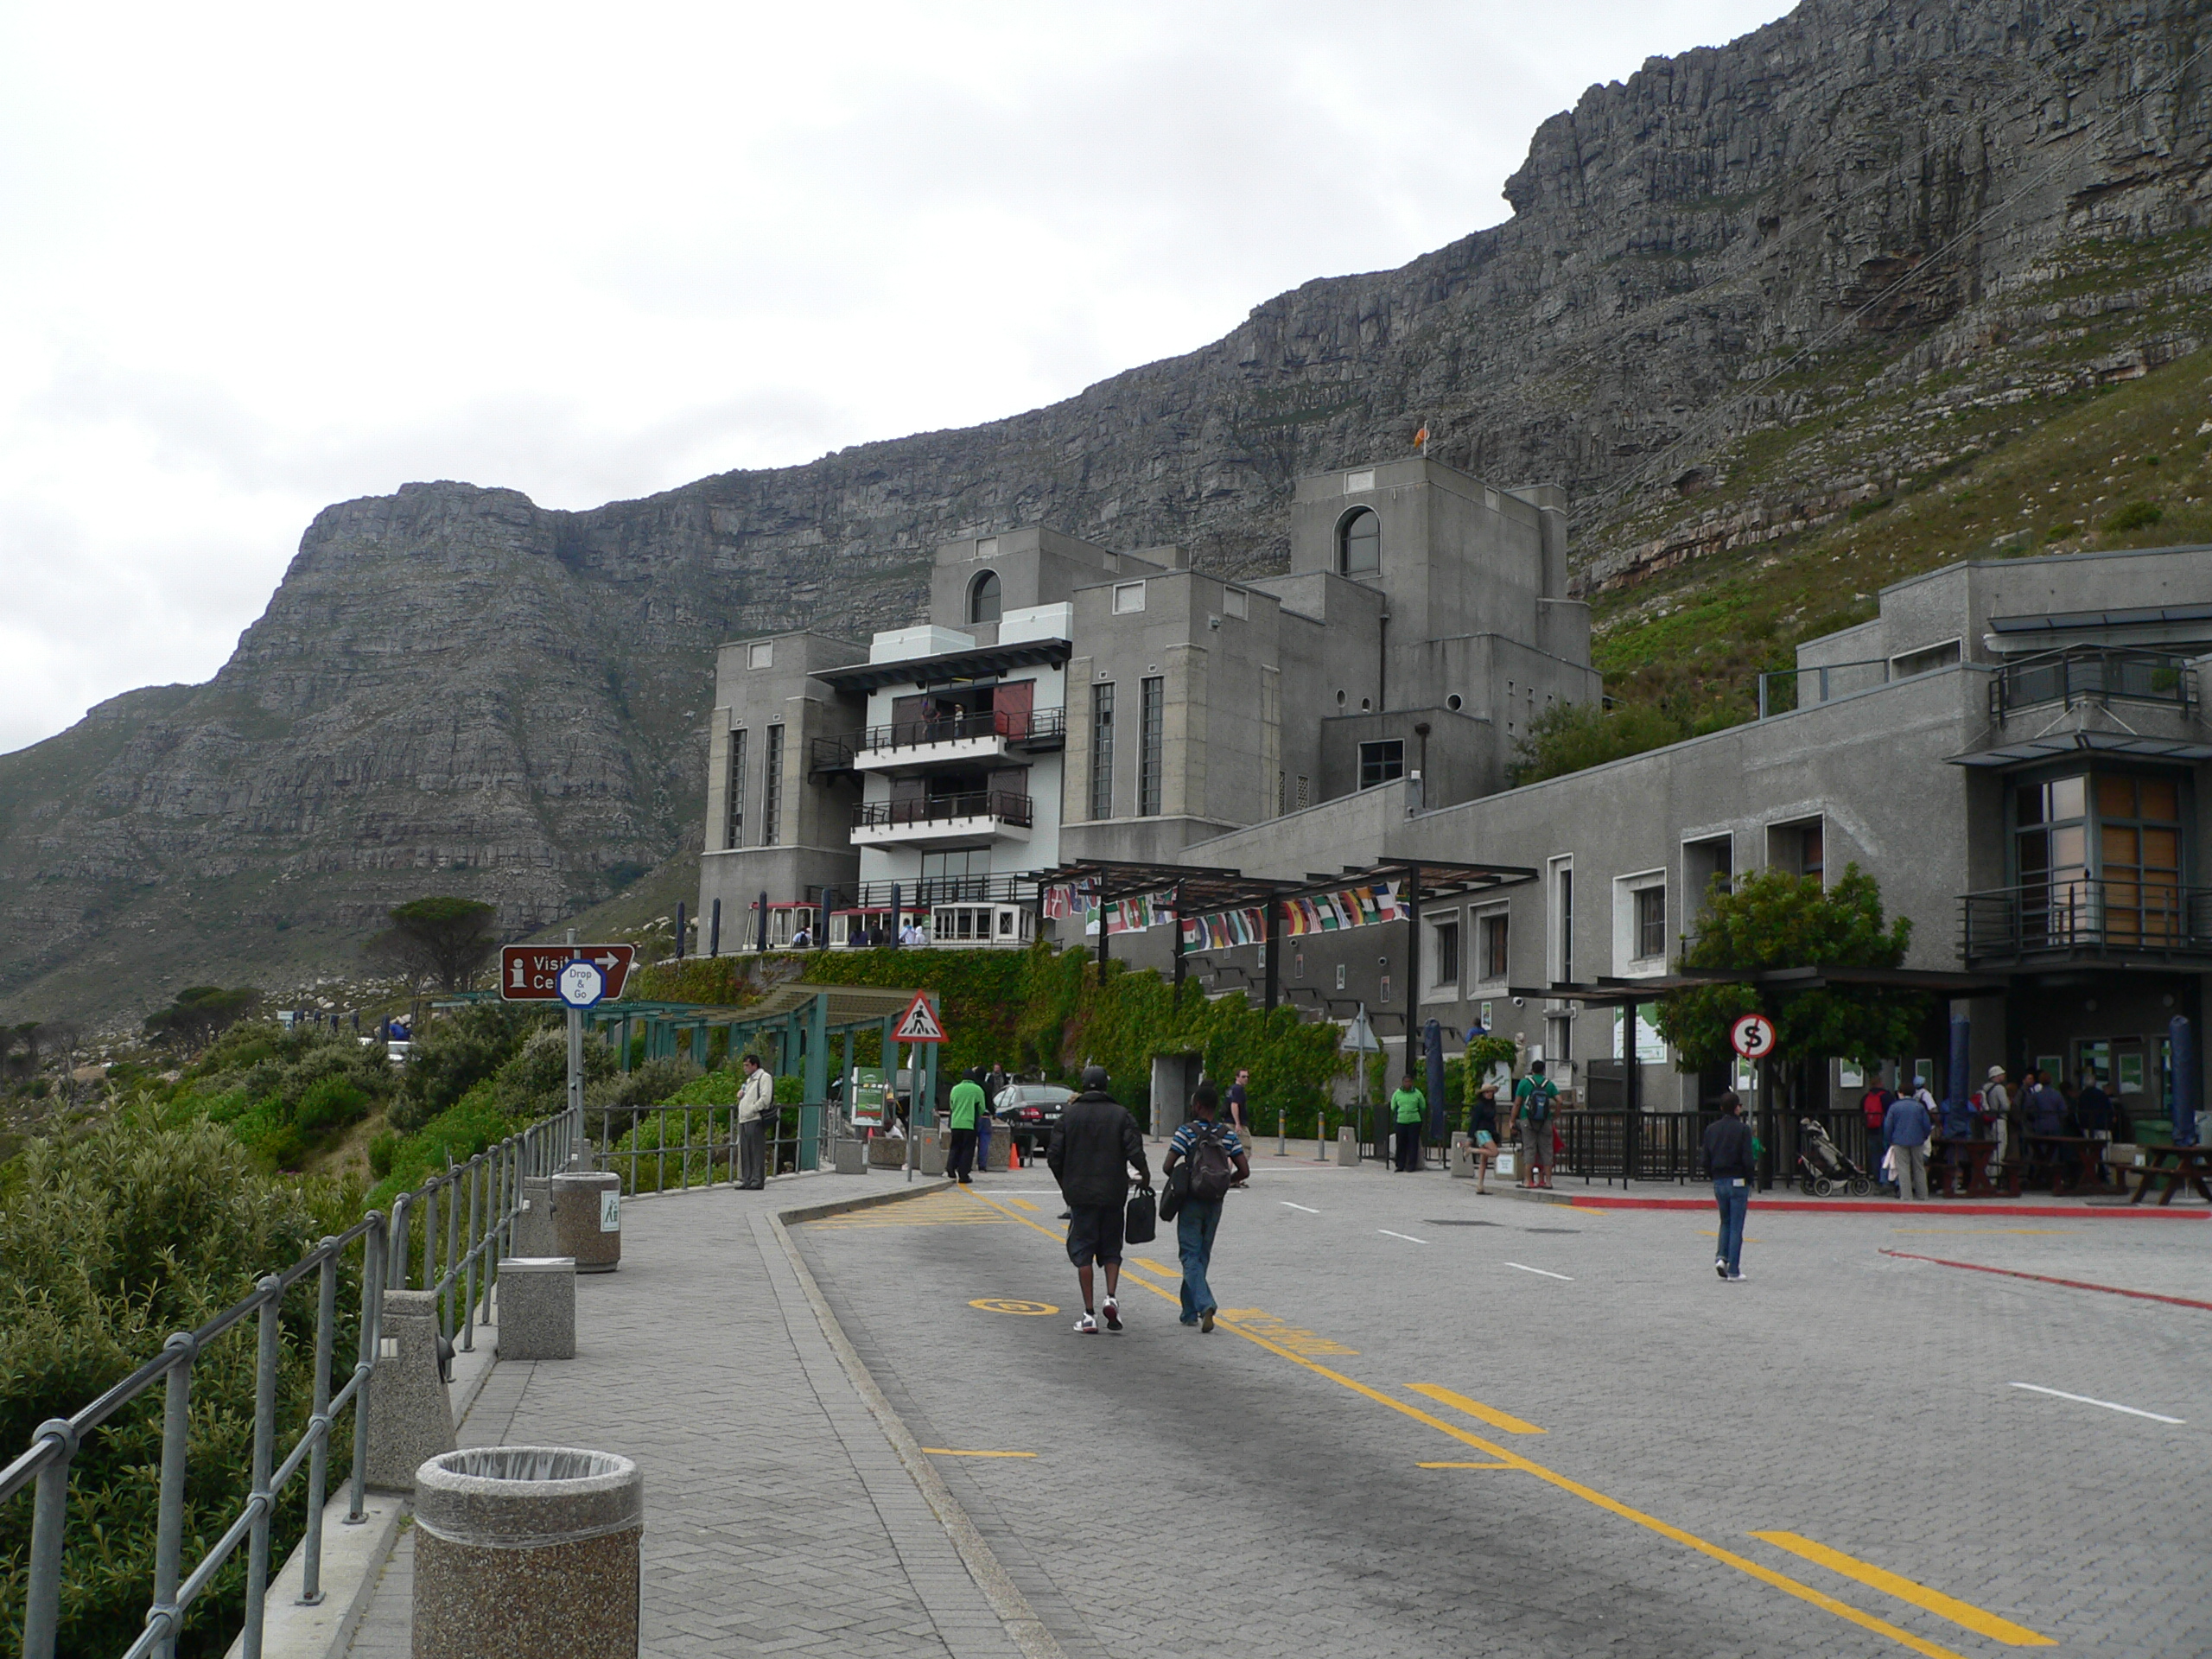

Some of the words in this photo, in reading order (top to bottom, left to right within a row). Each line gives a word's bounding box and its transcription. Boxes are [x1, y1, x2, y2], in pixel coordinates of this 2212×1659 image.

[569, 969, 592, 980] Drop
[533, 975, 557, 989] Ce
[577, 980, 584, 988] &
[575, 989, 587, 998] Go
[1745, 1026, 1763, 1047] S
